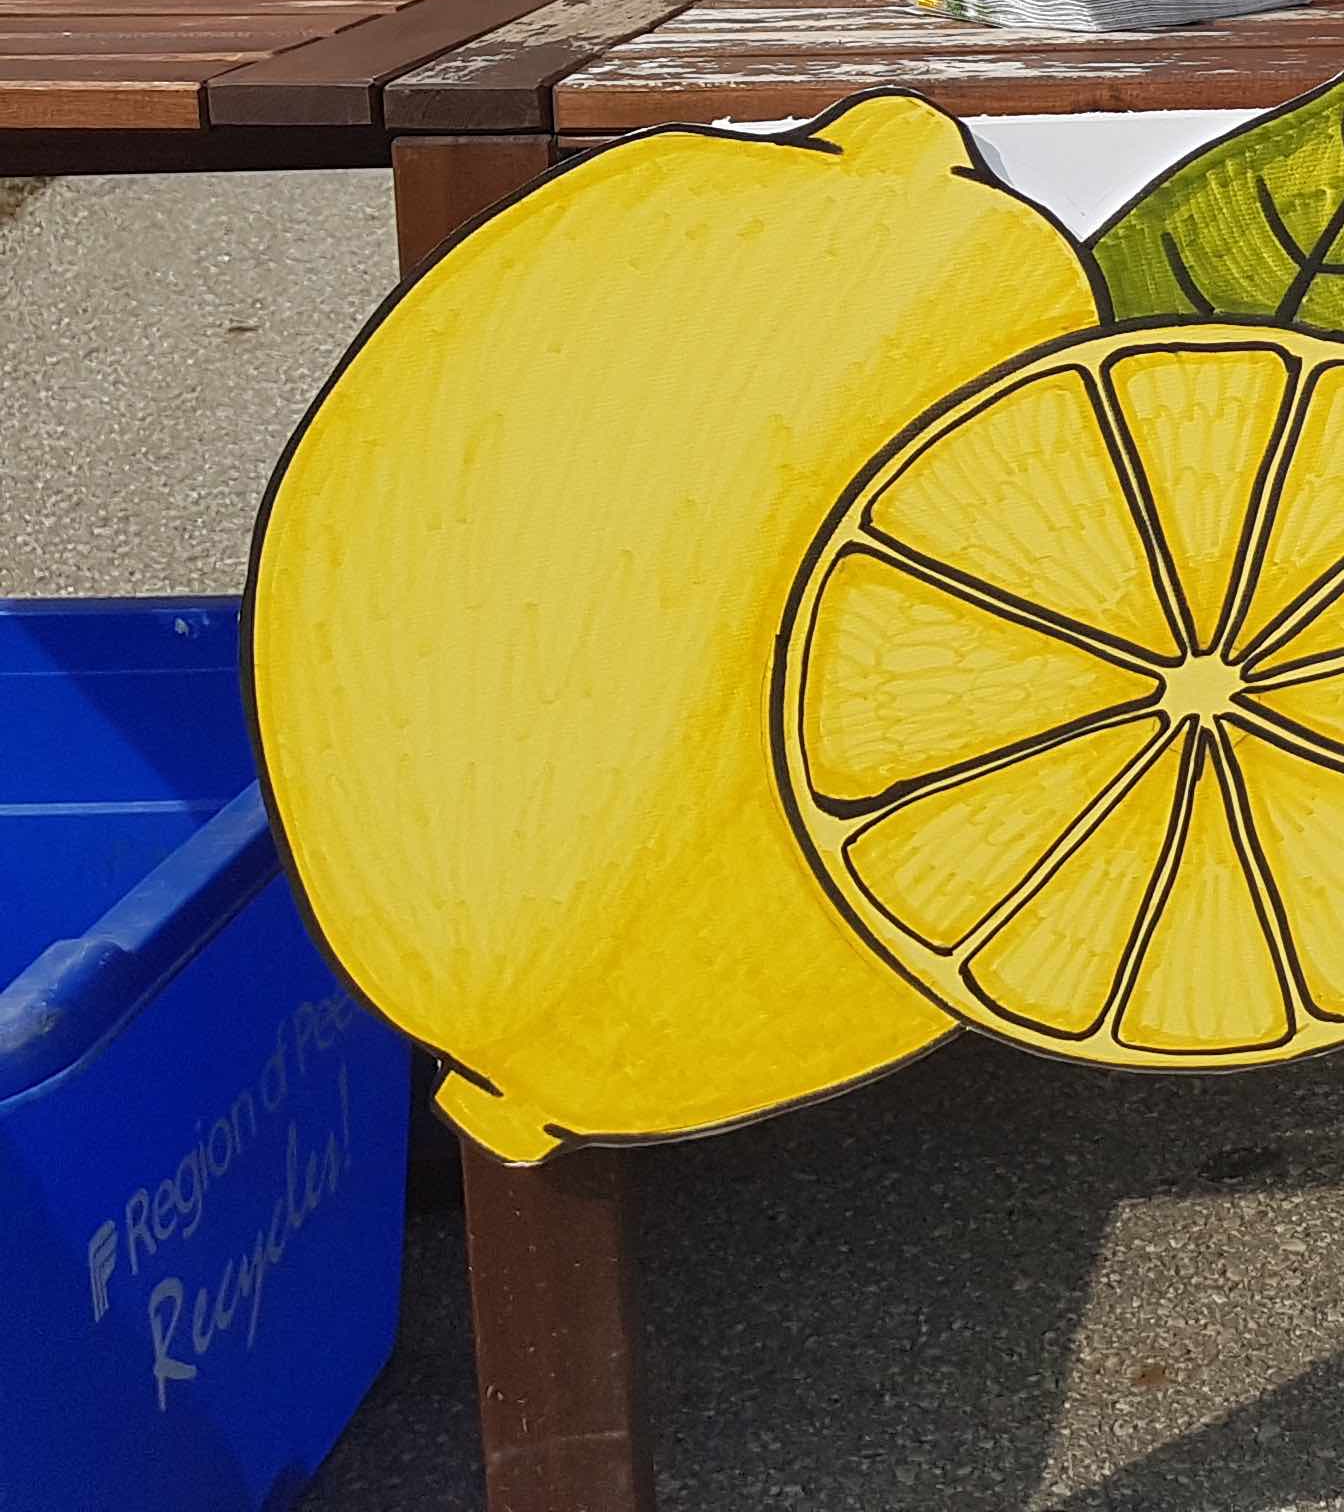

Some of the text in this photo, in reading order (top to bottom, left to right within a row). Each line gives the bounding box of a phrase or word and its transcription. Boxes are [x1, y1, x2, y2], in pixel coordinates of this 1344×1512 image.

[124, 993, 356, 1276] Region of Pee
